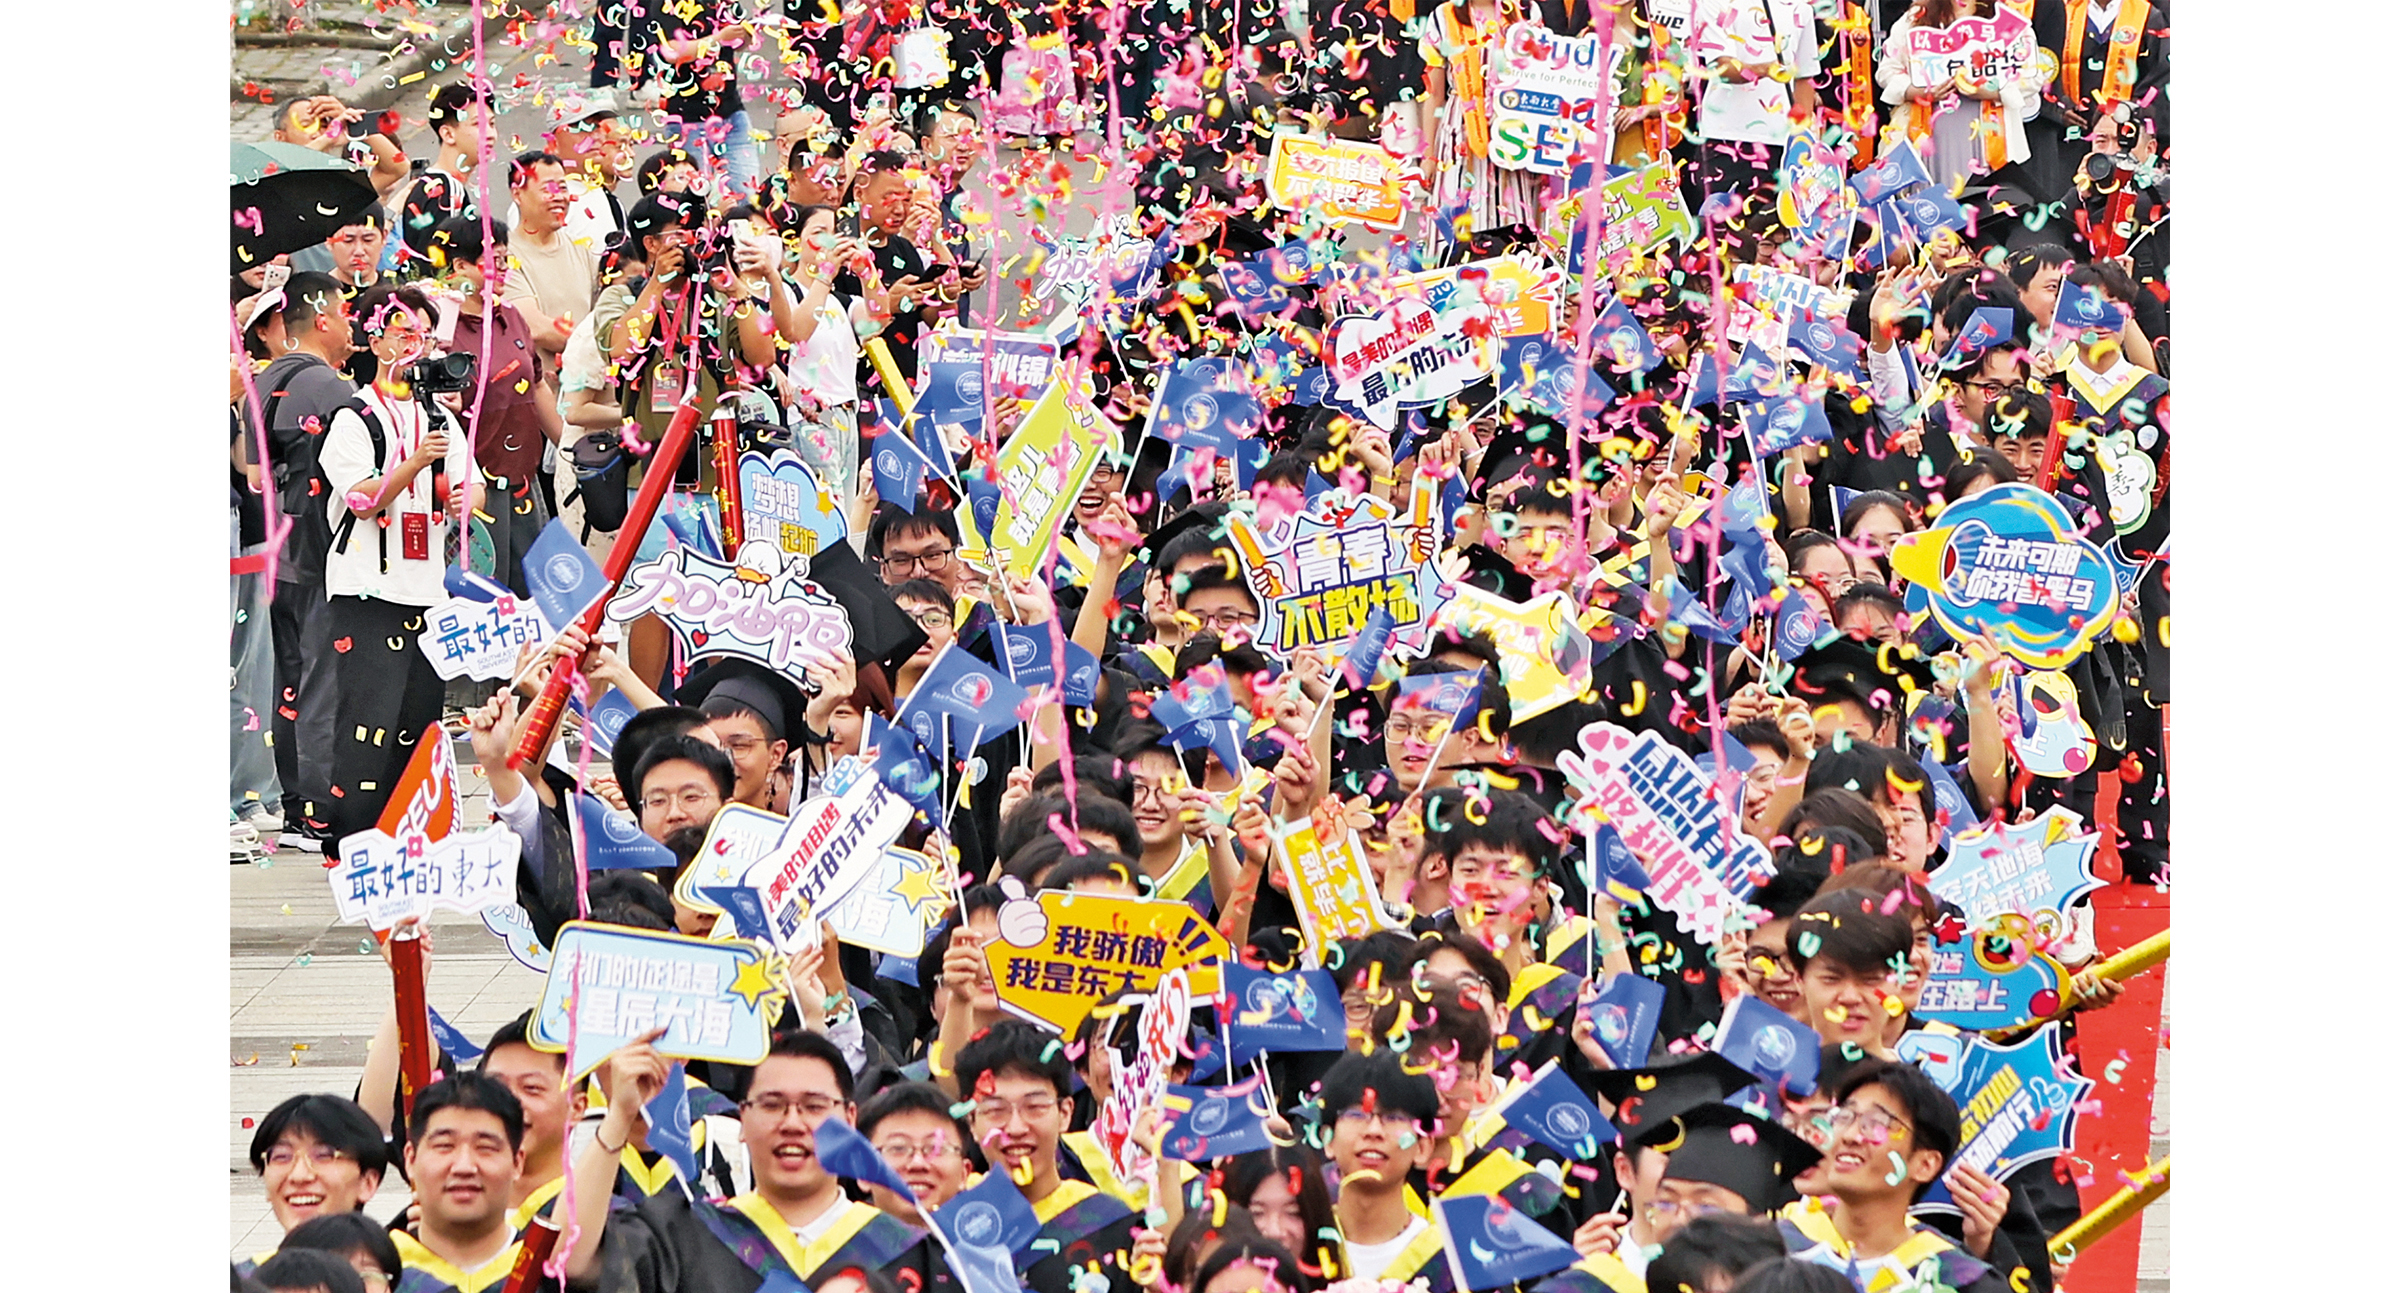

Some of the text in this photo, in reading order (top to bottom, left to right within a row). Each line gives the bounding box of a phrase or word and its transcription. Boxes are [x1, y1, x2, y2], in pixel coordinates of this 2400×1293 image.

[1650, 11, 1685, 29] ive
[1495, 118, 1608, 168] SE
[752, 472, 800, 523] 梦想
[1296, 526, 1389, 593] 青春
[1974, 534, 2084, 576] 未来可期
[436, 606, 543, 663] 最好的
[1278, 572, 1420, 650] 不散场
[1619, 737, 1772, 903] 感恩有你
[766, 801, 842, 913] 美的相遇
[558, 950, 720, 998] 我们的征途是
[1006, 957, 1146, 999] 我是东大
[580, 985, 734, 1048] 星辰大海
[1957, 1063, 2022, 1149] 初心
